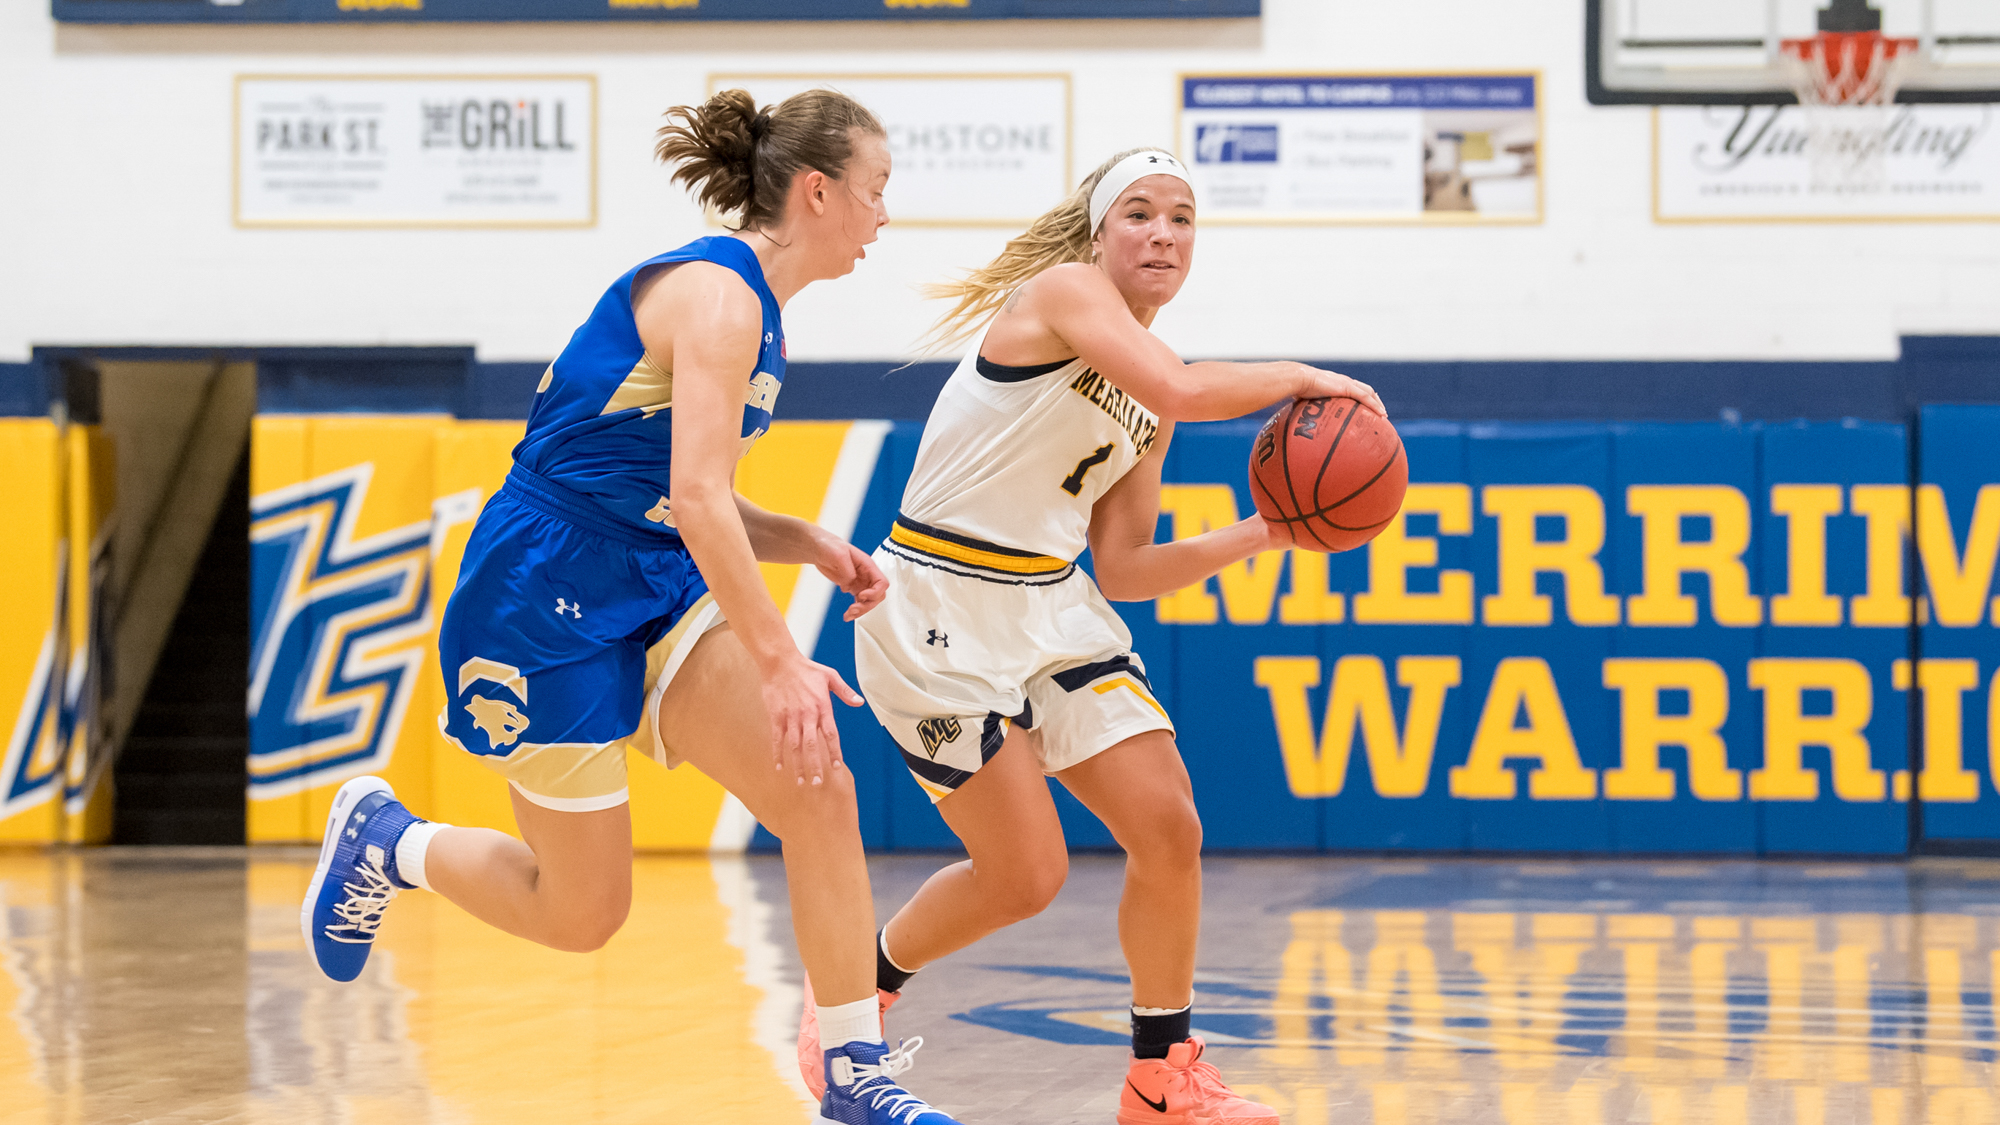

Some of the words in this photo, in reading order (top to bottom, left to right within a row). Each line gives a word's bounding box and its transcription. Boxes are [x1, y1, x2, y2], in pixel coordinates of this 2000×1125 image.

[256, 119, 338, 153] PARK
[887, 124, 1054, 153] CHSTONE
[1293, 396, 1333, 440] NCA
[1059, 441, 1116, 498] 1
[1254, 655, 2000, 801] WARRI
